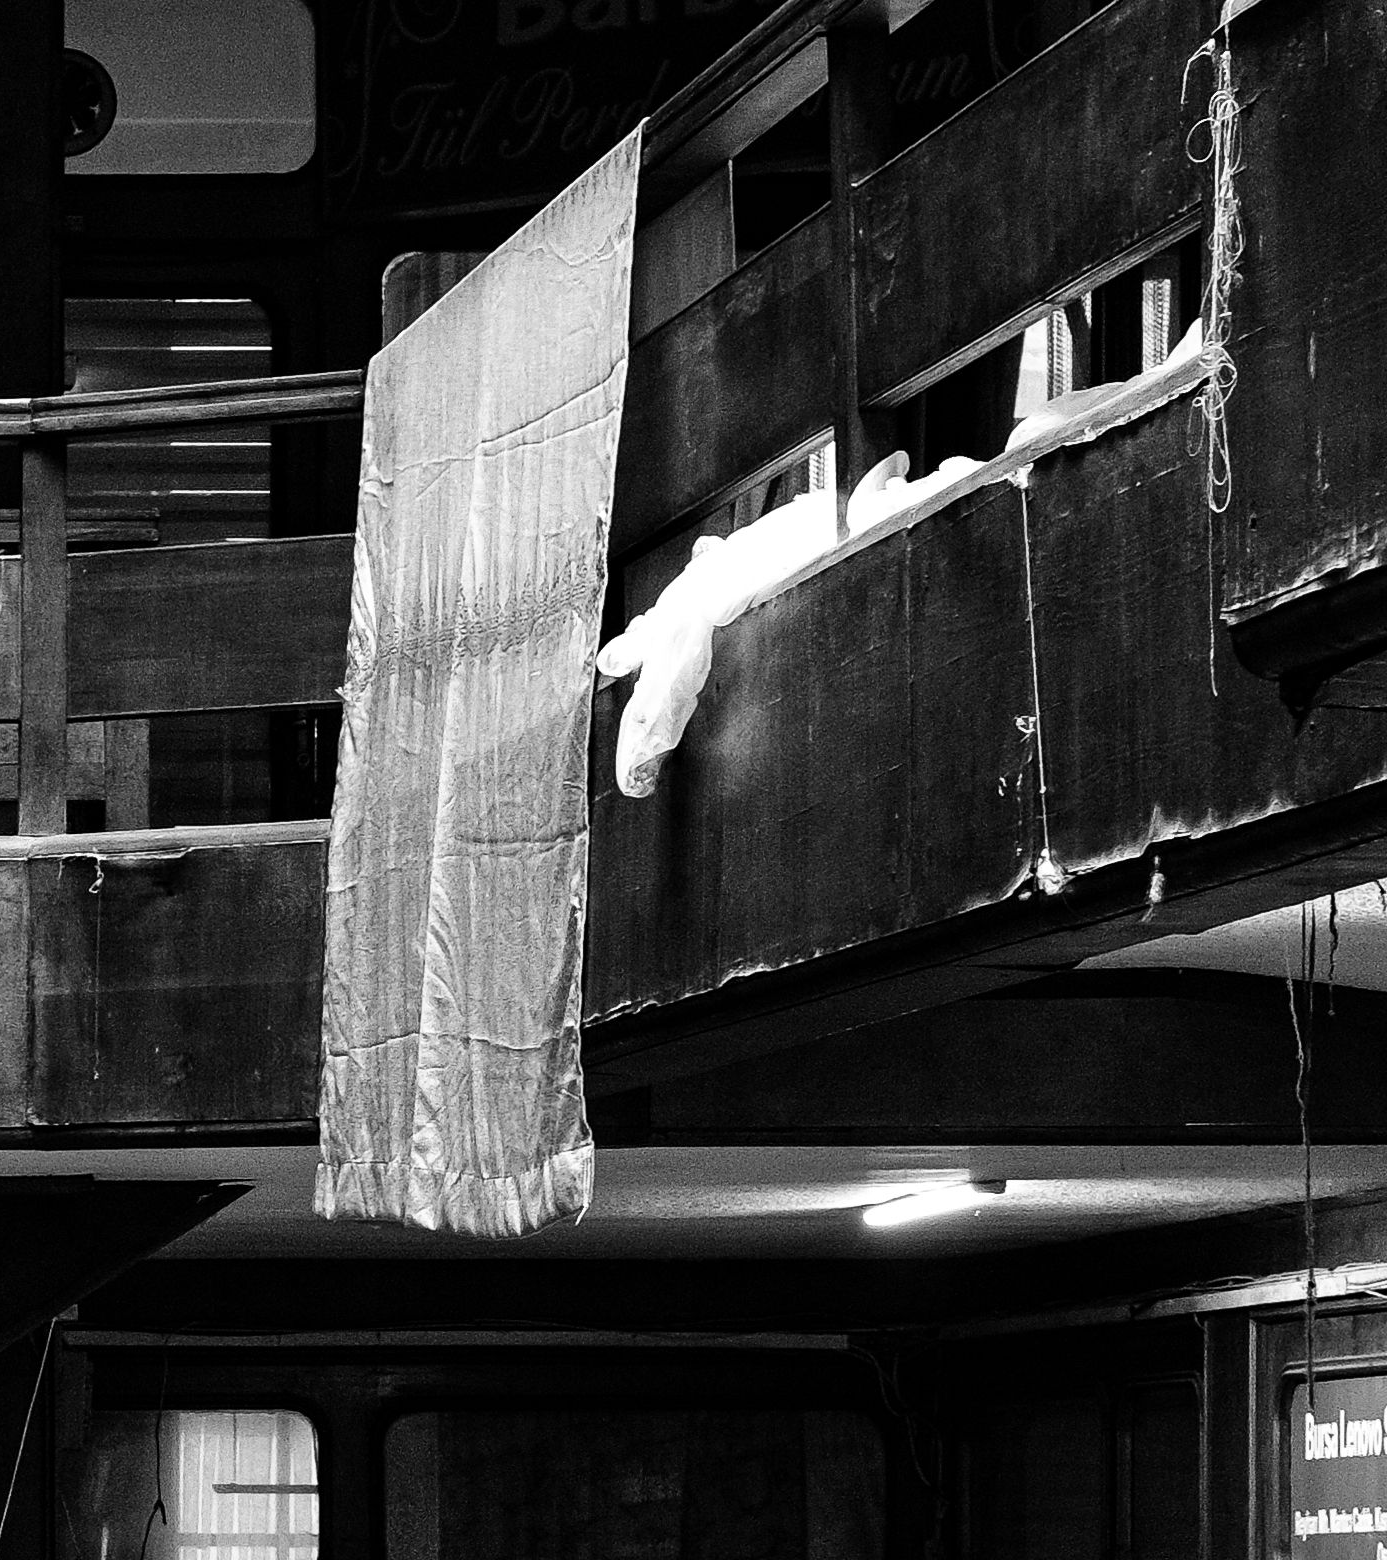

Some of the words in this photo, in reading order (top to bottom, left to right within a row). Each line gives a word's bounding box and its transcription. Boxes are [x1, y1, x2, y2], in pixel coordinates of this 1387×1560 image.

[377, 74, 510, 177] Tül
[1305, 1412, 1338, 1460] Bursa
[1339, 1409, 1383, 1458] Lenovo
